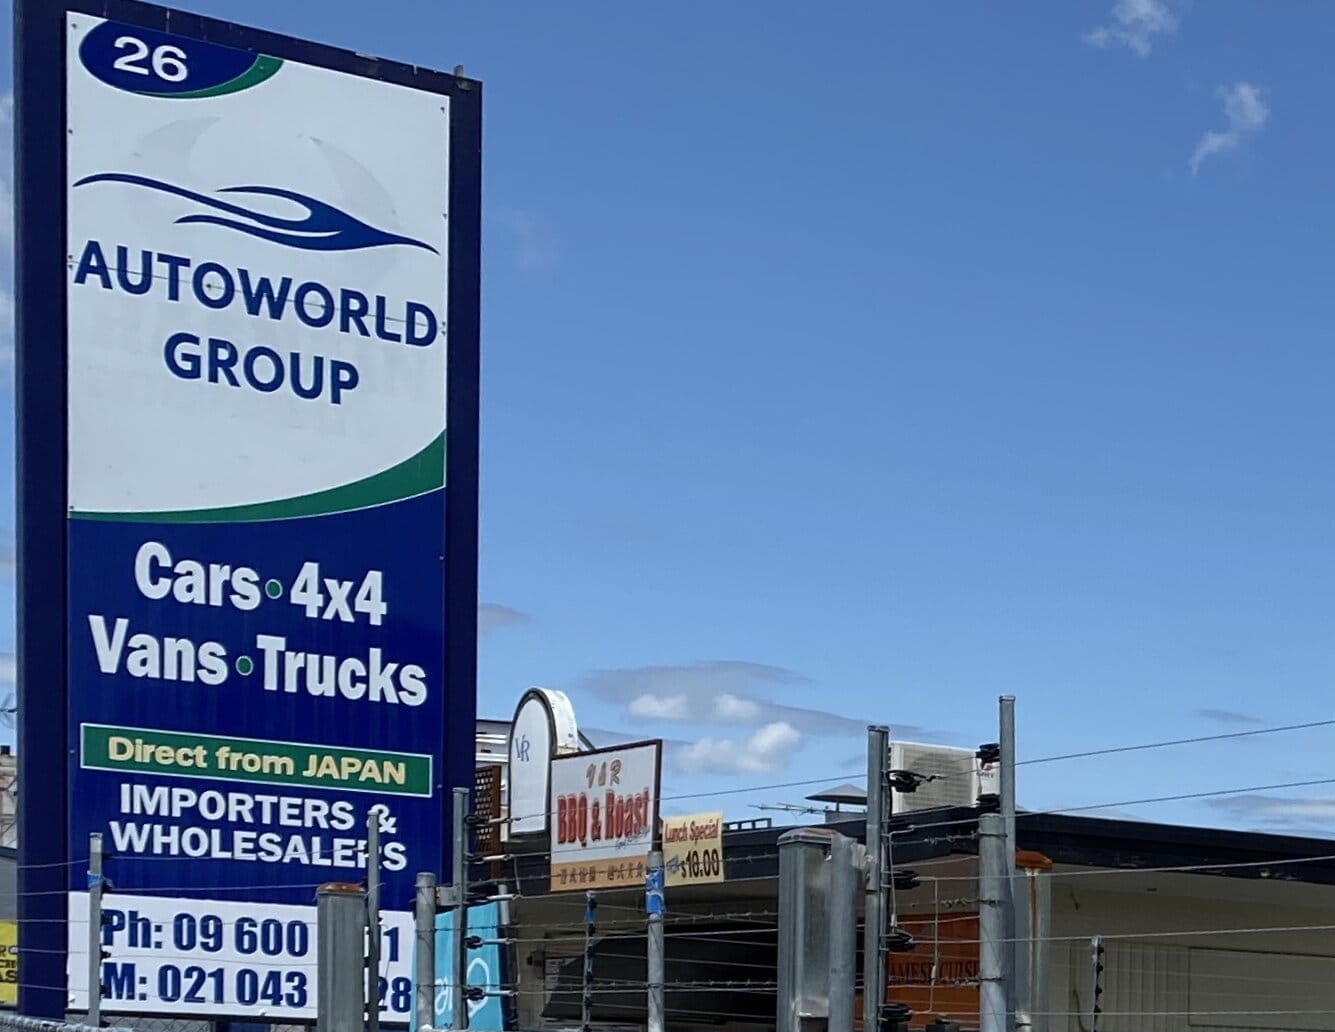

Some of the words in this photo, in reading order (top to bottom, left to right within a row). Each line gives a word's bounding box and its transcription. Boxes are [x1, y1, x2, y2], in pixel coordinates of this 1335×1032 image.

[113, 36, 188, 82] 26
[74, 240, 438, 347] AUTOWORLD
[164, 333, 359, 405] GROUP
[134, 541, 261, 610] Cars
[290, 561, 388, 625] 4x4
[88, 615, 228, 686] Vans
[256, 634, 427, 706] Trucks
[108, 736, 207, 768] Direct
[216, 746, 295, 776] from
[302, 755, 406, 784] JAPAN
[120, 784, 355, 831] IMPORTERS
[366, 804, 397, 834] &
[557, 792, 587, 847] BBQ
[591, 797, 602, 841] &
[605, 787, 649, 840] Roast
[665, 823, 688, 843] Lunch
[690, 818, 719, 846] Special
[680, 848, 719, 879] $10.00
[102, 909, 162, 949] Ph:
[173, 913, 223, 952] 09
[235, 917, 308, 957] 600
[102, 962, 147, 1001] M:
[158, 964, 224, 1004] 021
[236, 968, 307, 1008] 043
